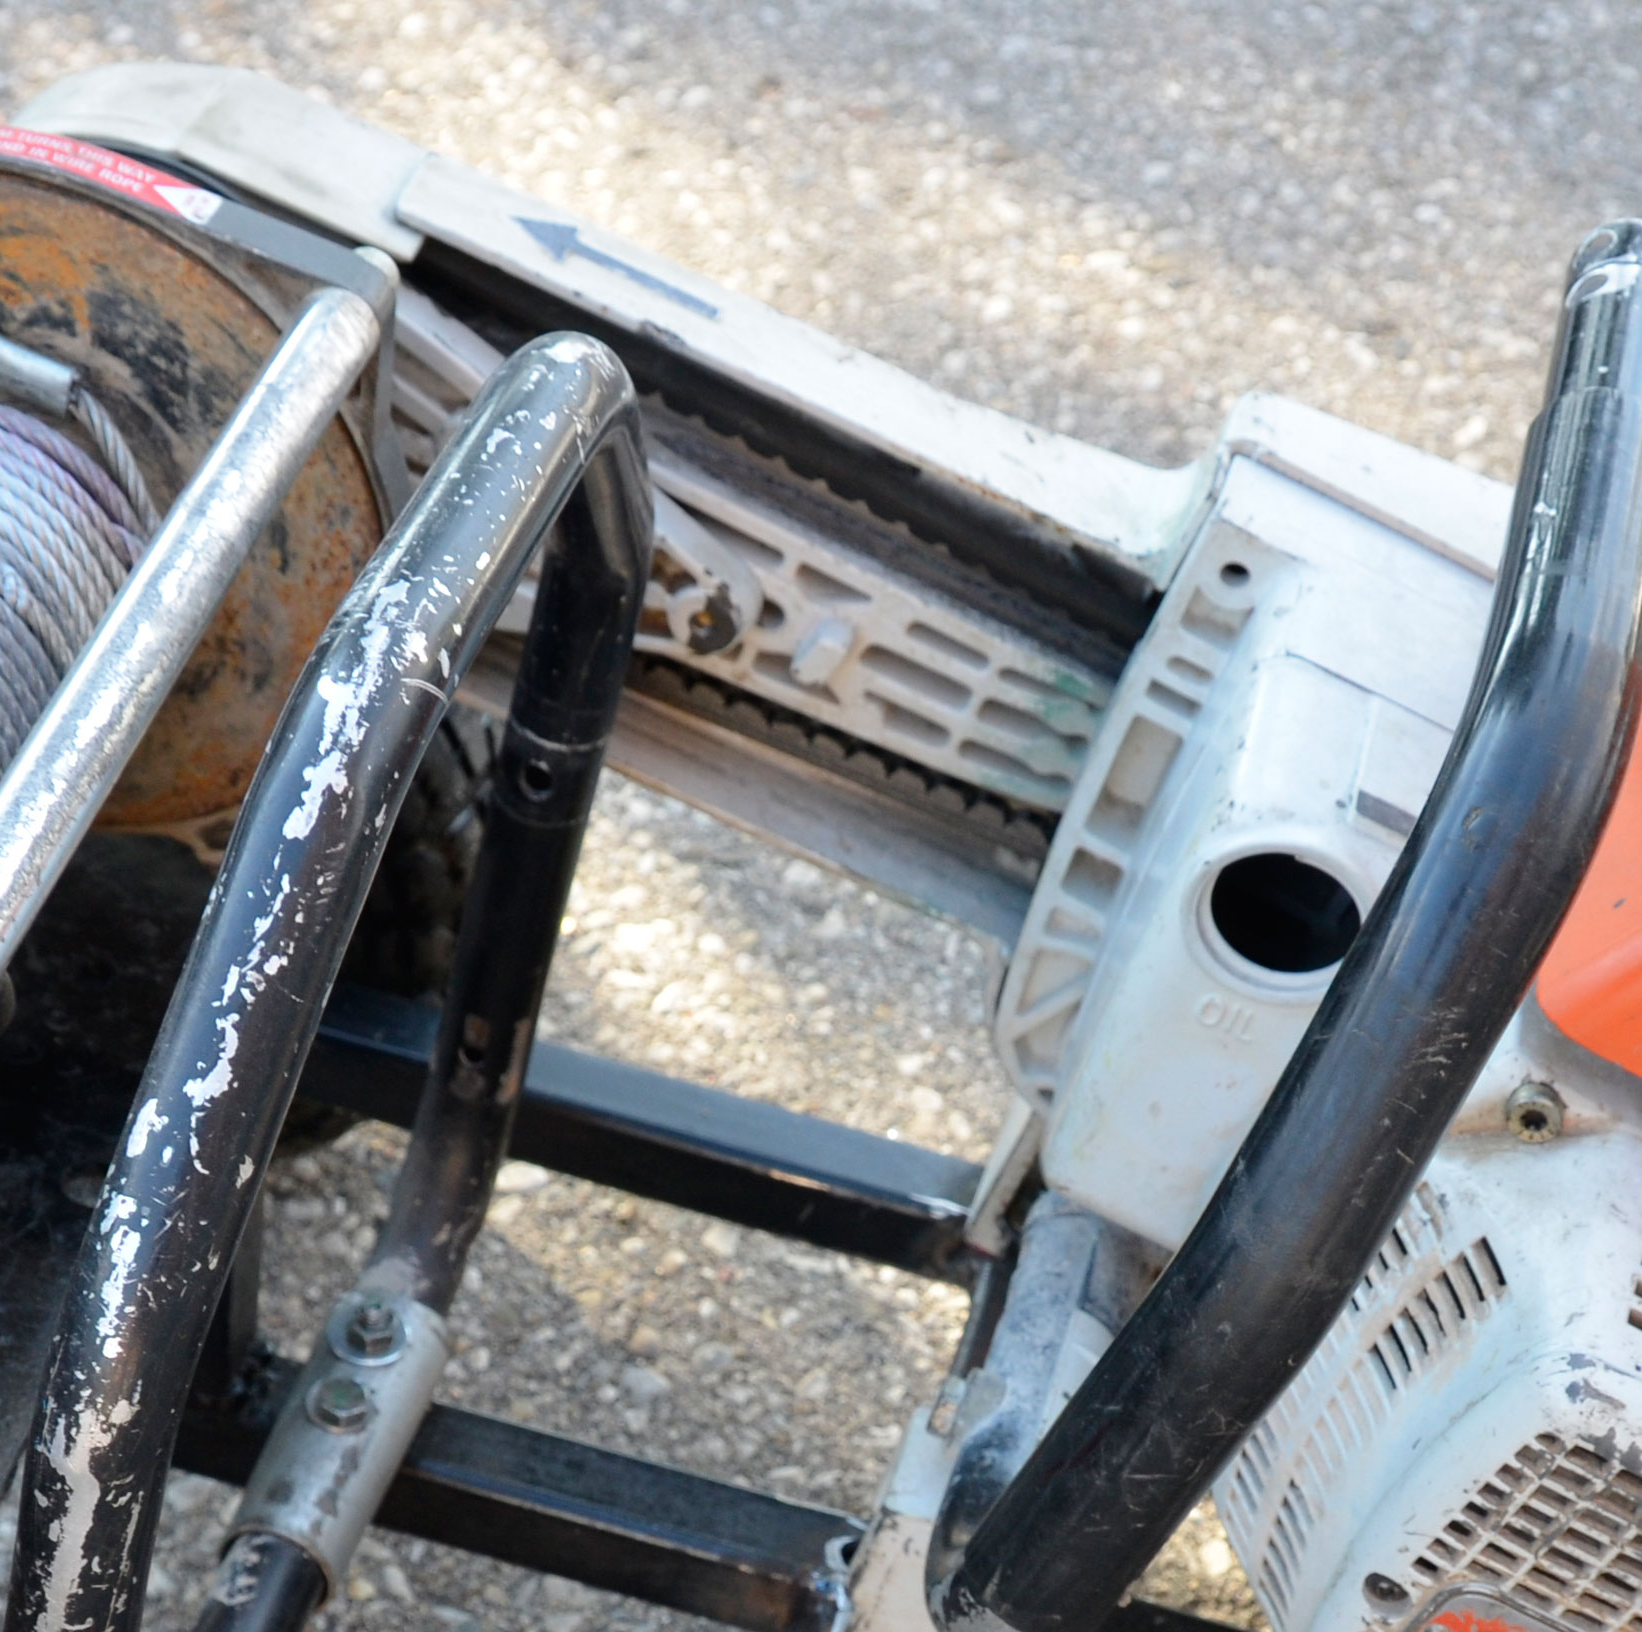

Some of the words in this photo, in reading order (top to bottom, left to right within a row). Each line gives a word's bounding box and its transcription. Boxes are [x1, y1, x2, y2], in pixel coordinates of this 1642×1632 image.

[99, 167, 144, 192] ROPE
[117, 159, 156, 183] WAY
[1196, 994, 1256, 1044] OIL
